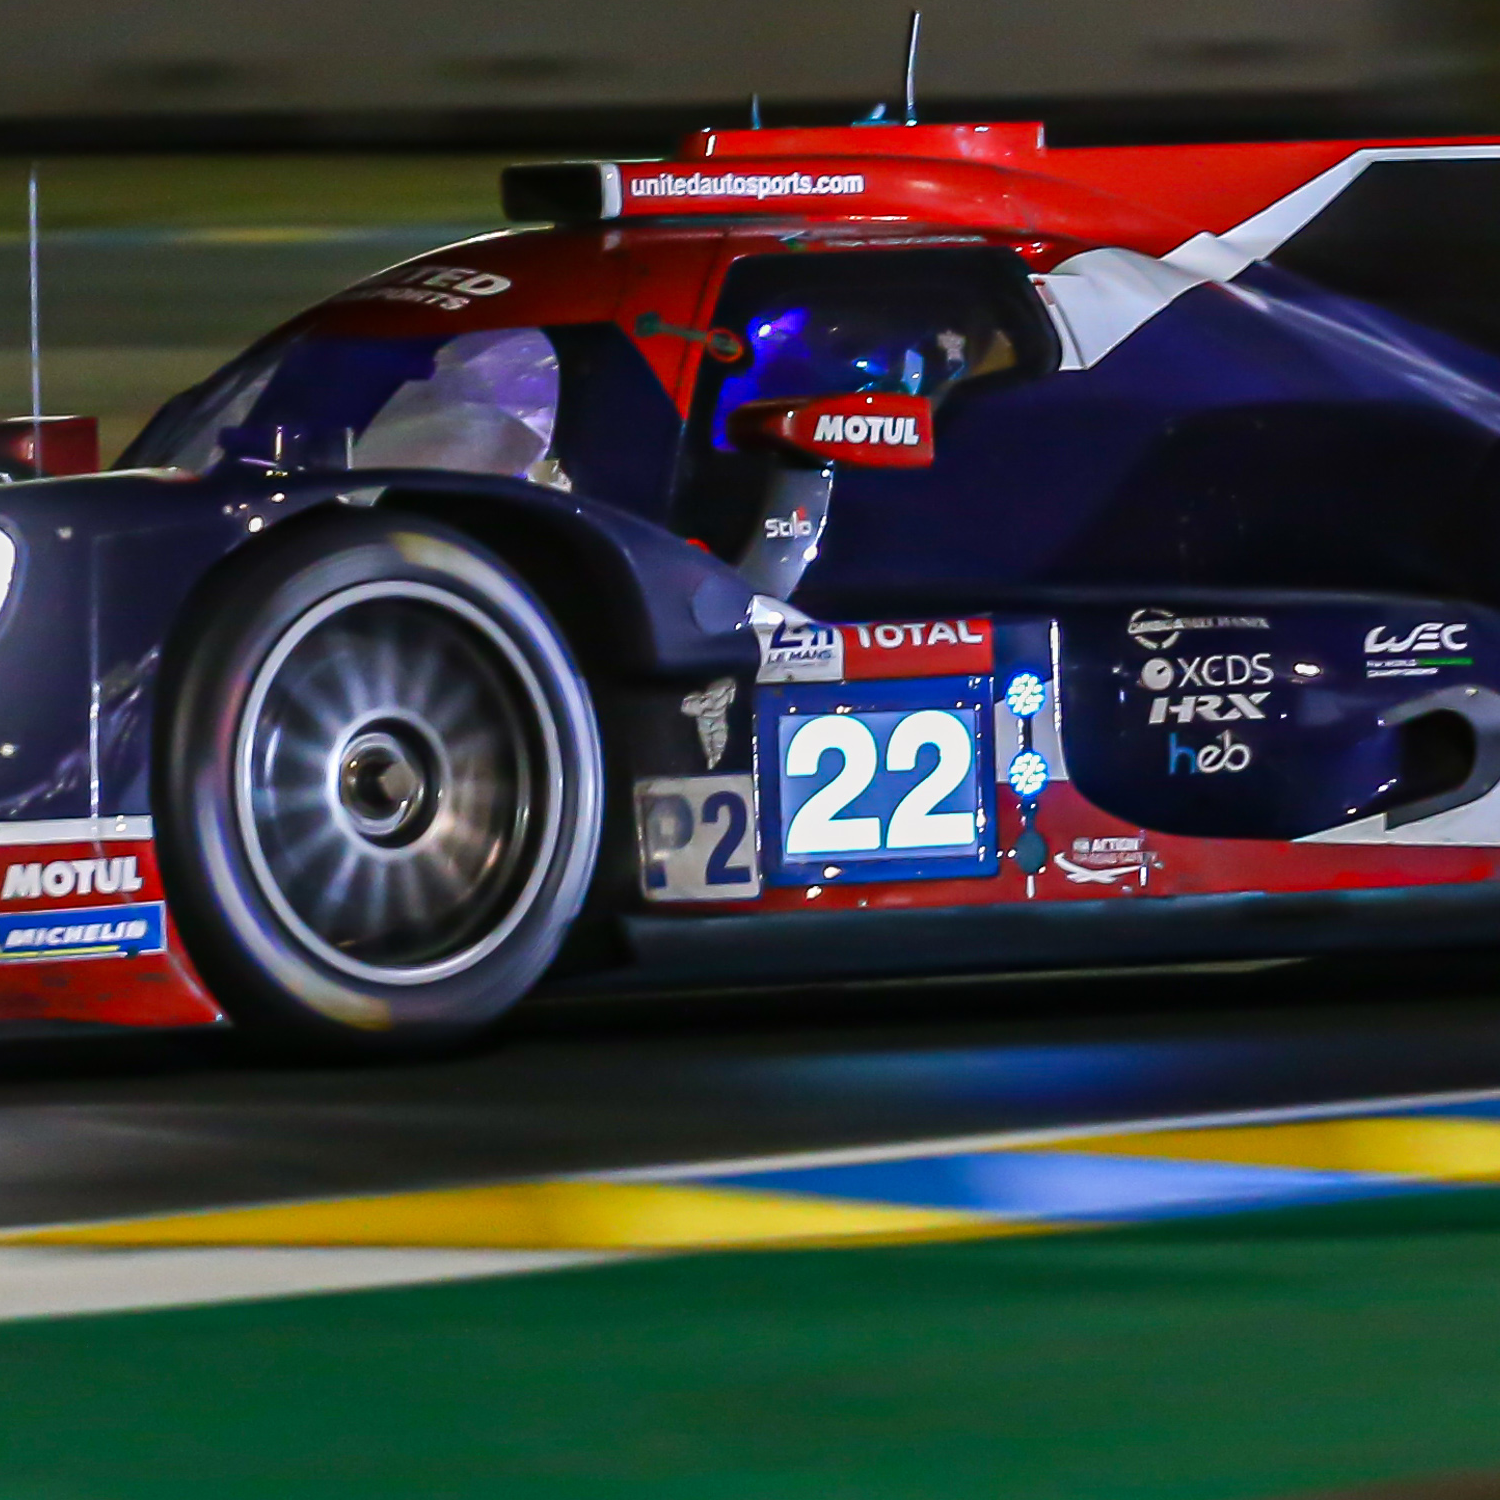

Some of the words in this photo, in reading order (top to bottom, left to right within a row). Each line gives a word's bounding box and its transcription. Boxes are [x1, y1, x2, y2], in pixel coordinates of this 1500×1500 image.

[631, 172, 864, 200] unitedautosports.com
[813, 412, 920, 445] MOTUL
[854, 619, 984, 648] TOTAL
[1364, 622, 1468, 653] WEC
[1177, 653, 1275, 687] XCDS
[1148, 691, 1272, 725] HRX
[786, 710, 977, 853] 22
[641, 790, 751, 888] P2
[1, 856, 144, 900] MOTUL
[5, 917, 148, 948] MICHELIN
